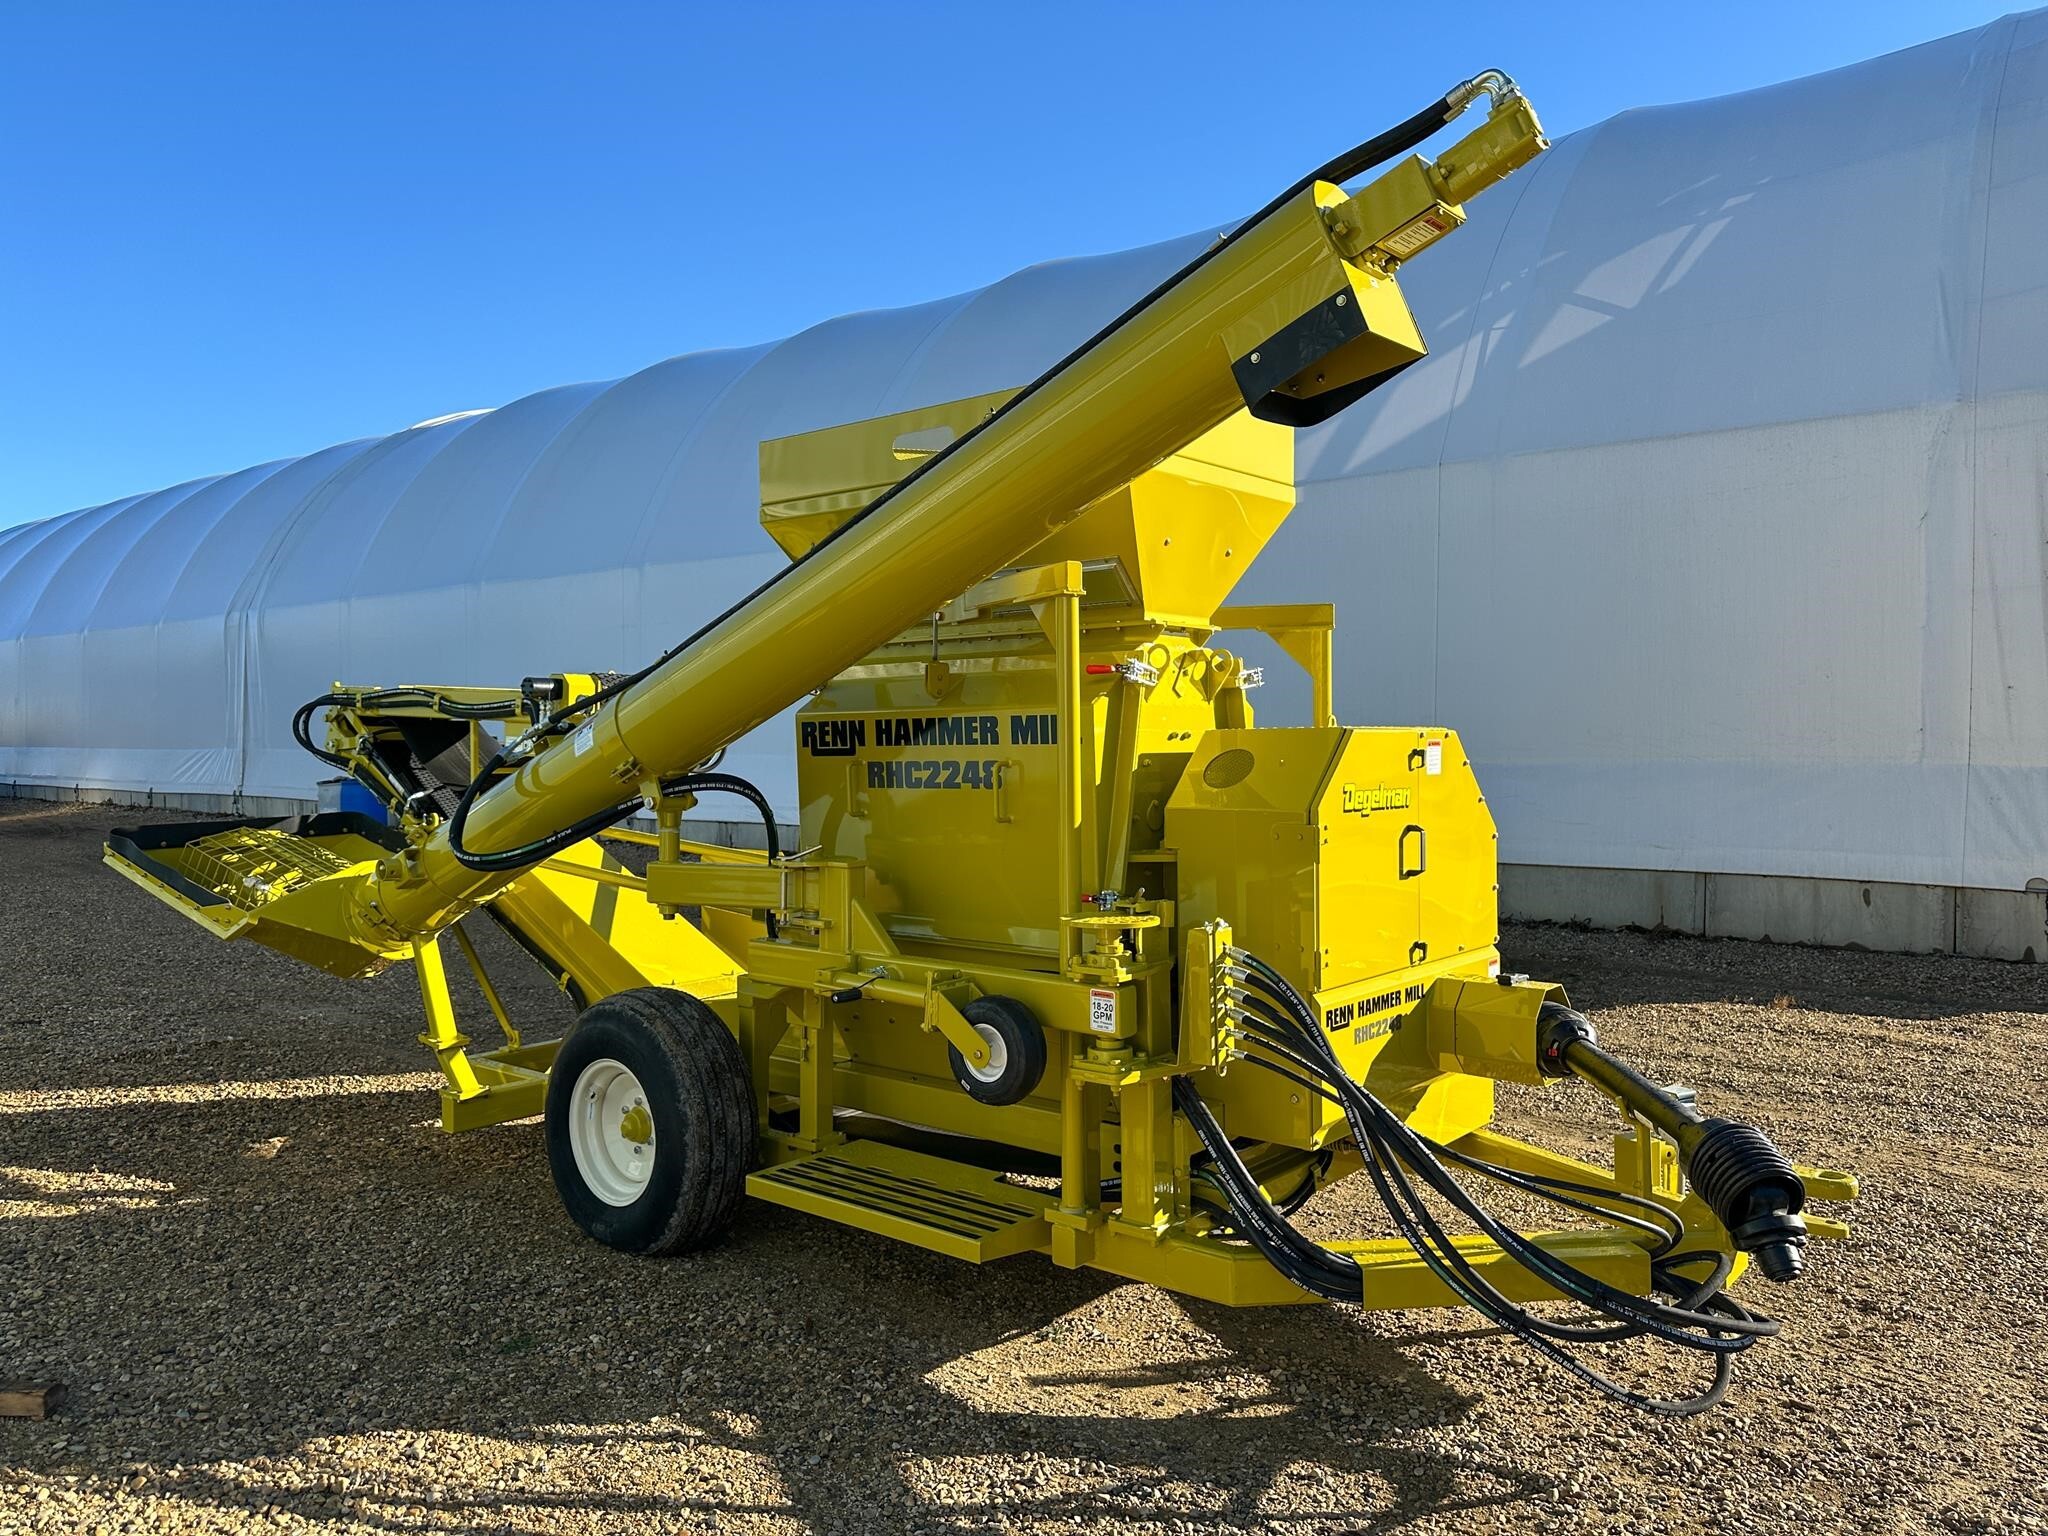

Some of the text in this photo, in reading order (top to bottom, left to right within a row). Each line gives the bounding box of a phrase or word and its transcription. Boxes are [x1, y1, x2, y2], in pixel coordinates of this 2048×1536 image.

[801, 719, 866, 756] RENN
[875, 715, 999, 747] HAMMER
[1343, 782, 1410, 817] Degelman
[1093, 1001, 1114, 1012] 18-20
[1093, 1010, 1113, 1021] GPM
[1326, 983, 1426, 1032] RENN HAMMER MILL
[1400, 1223, 1425, 1254] PULSAR
